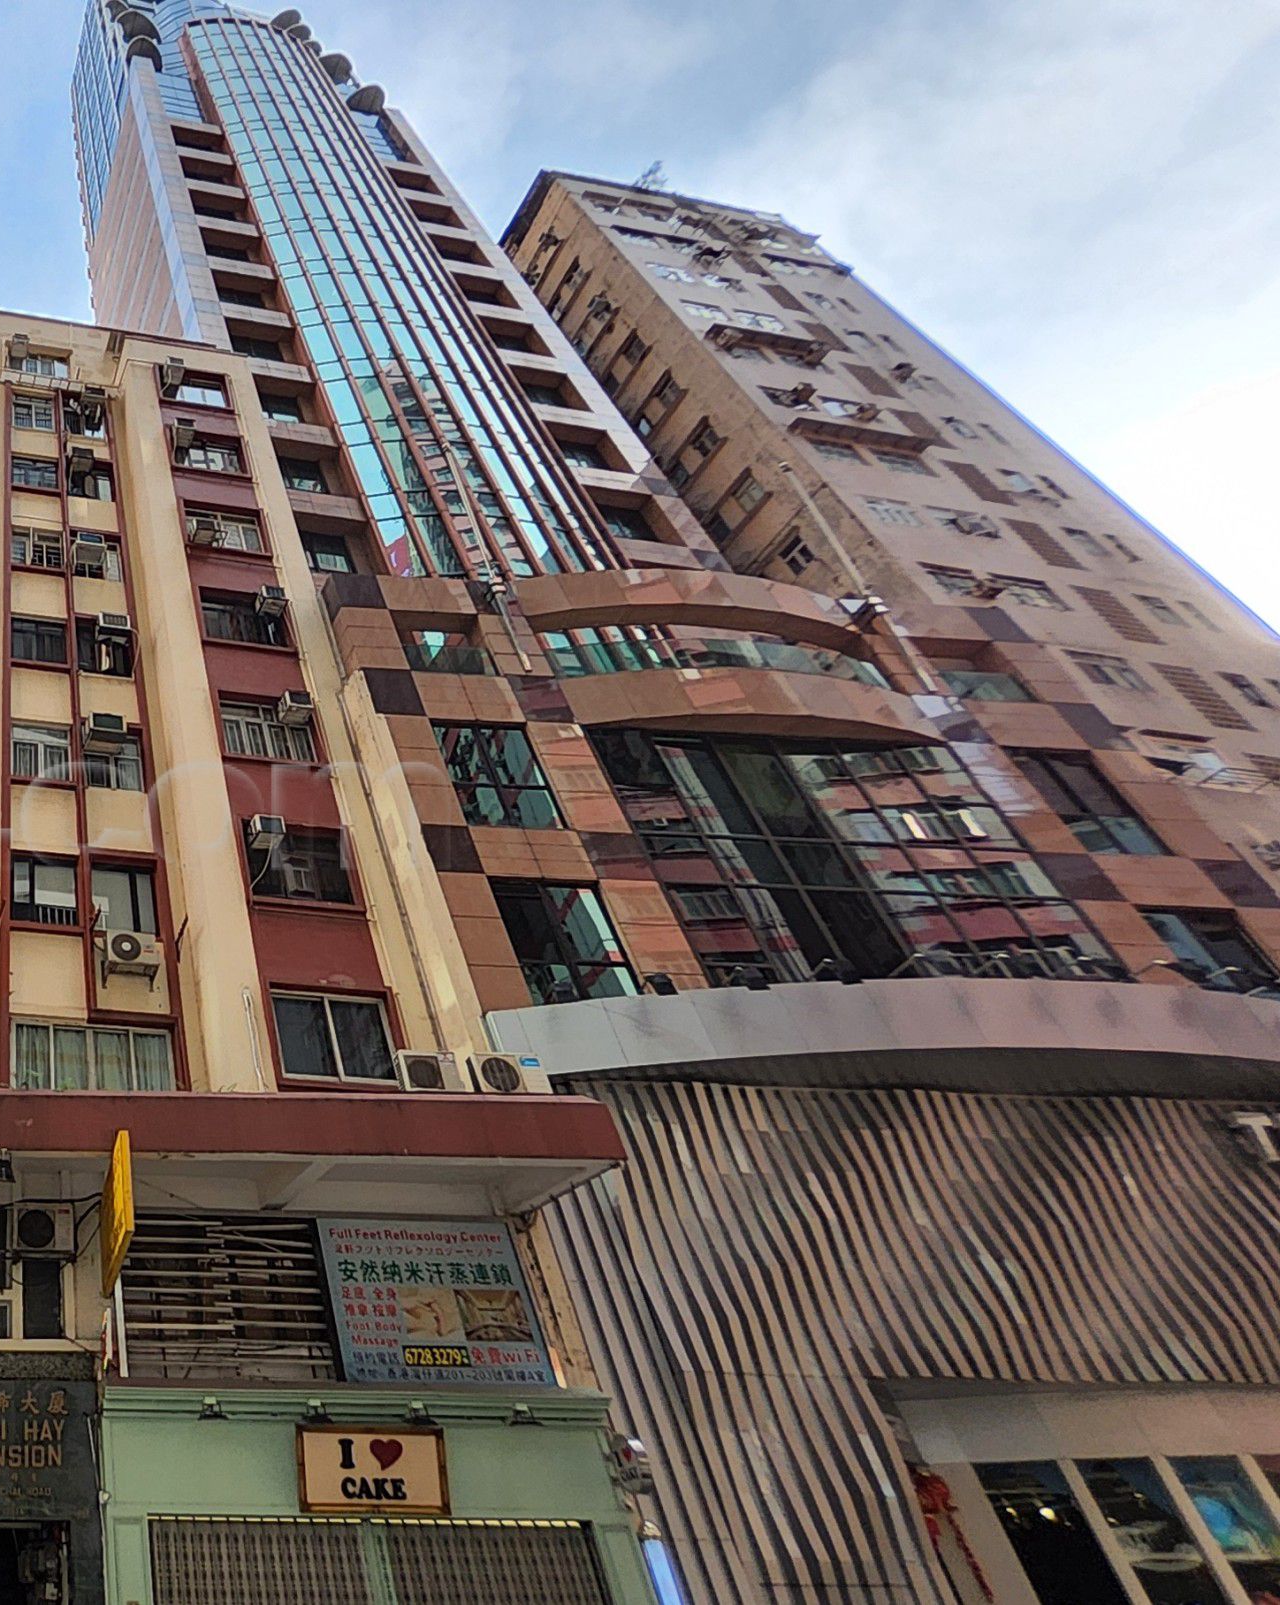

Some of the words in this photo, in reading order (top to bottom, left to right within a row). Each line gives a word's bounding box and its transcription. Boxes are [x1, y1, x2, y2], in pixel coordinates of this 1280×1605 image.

[328, 1228, 352, 1239] Full
[355, 1228, 382, 1240] Feet
[384, 1229, 457, 1243] Reflexology
[460, 1232, 501, 1243] Center
[338, 1260, 514, 1287] 安然納米汗蒸連鎖
[345, 1320, 370, 1332] Foot
[375, 1320, 401, 1333] Body
[351, 1335, 399, 1348] Massage
[24, 1419, 65, 1441] HAY
[338, 1438, 356, 1469] I
[341, 1476, 407, 1501] CAKE
